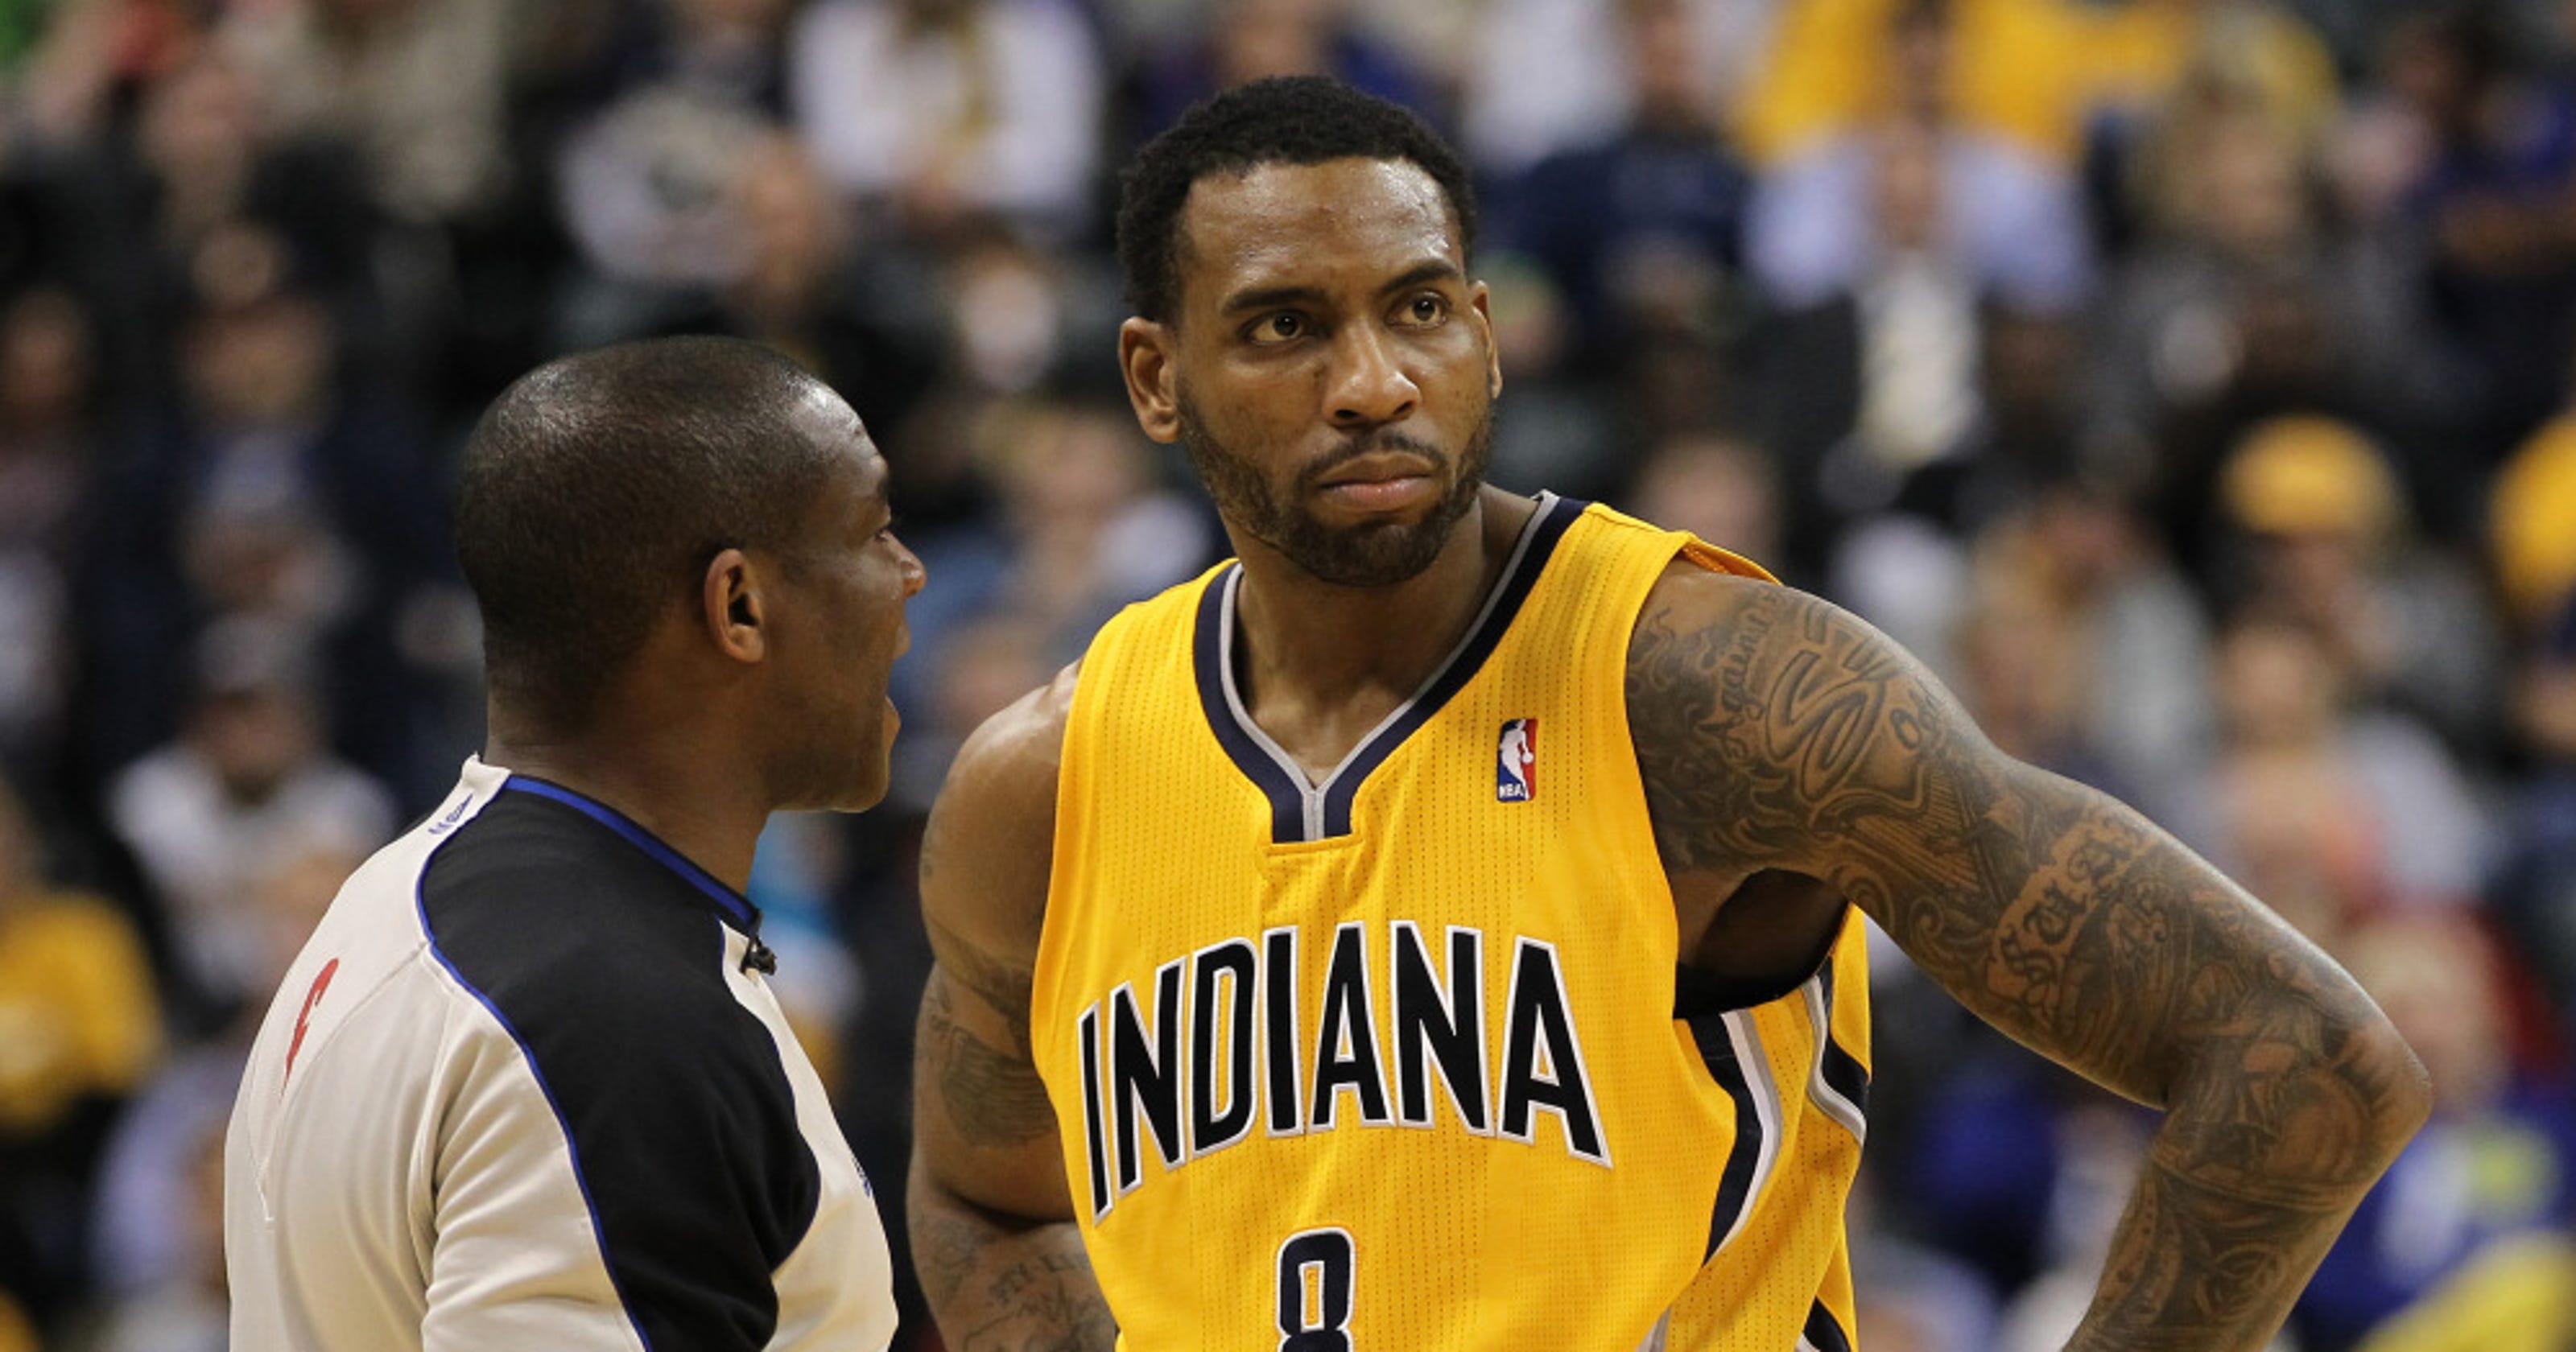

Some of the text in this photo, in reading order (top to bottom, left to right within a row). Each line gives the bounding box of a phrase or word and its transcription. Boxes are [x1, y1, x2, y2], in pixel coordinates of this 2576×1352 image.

[1498, 783, 1526, 798] NBA
[1078, 920, 1612, 1225] INDIANA
[1277, 1226, 1356, 1352] 8
